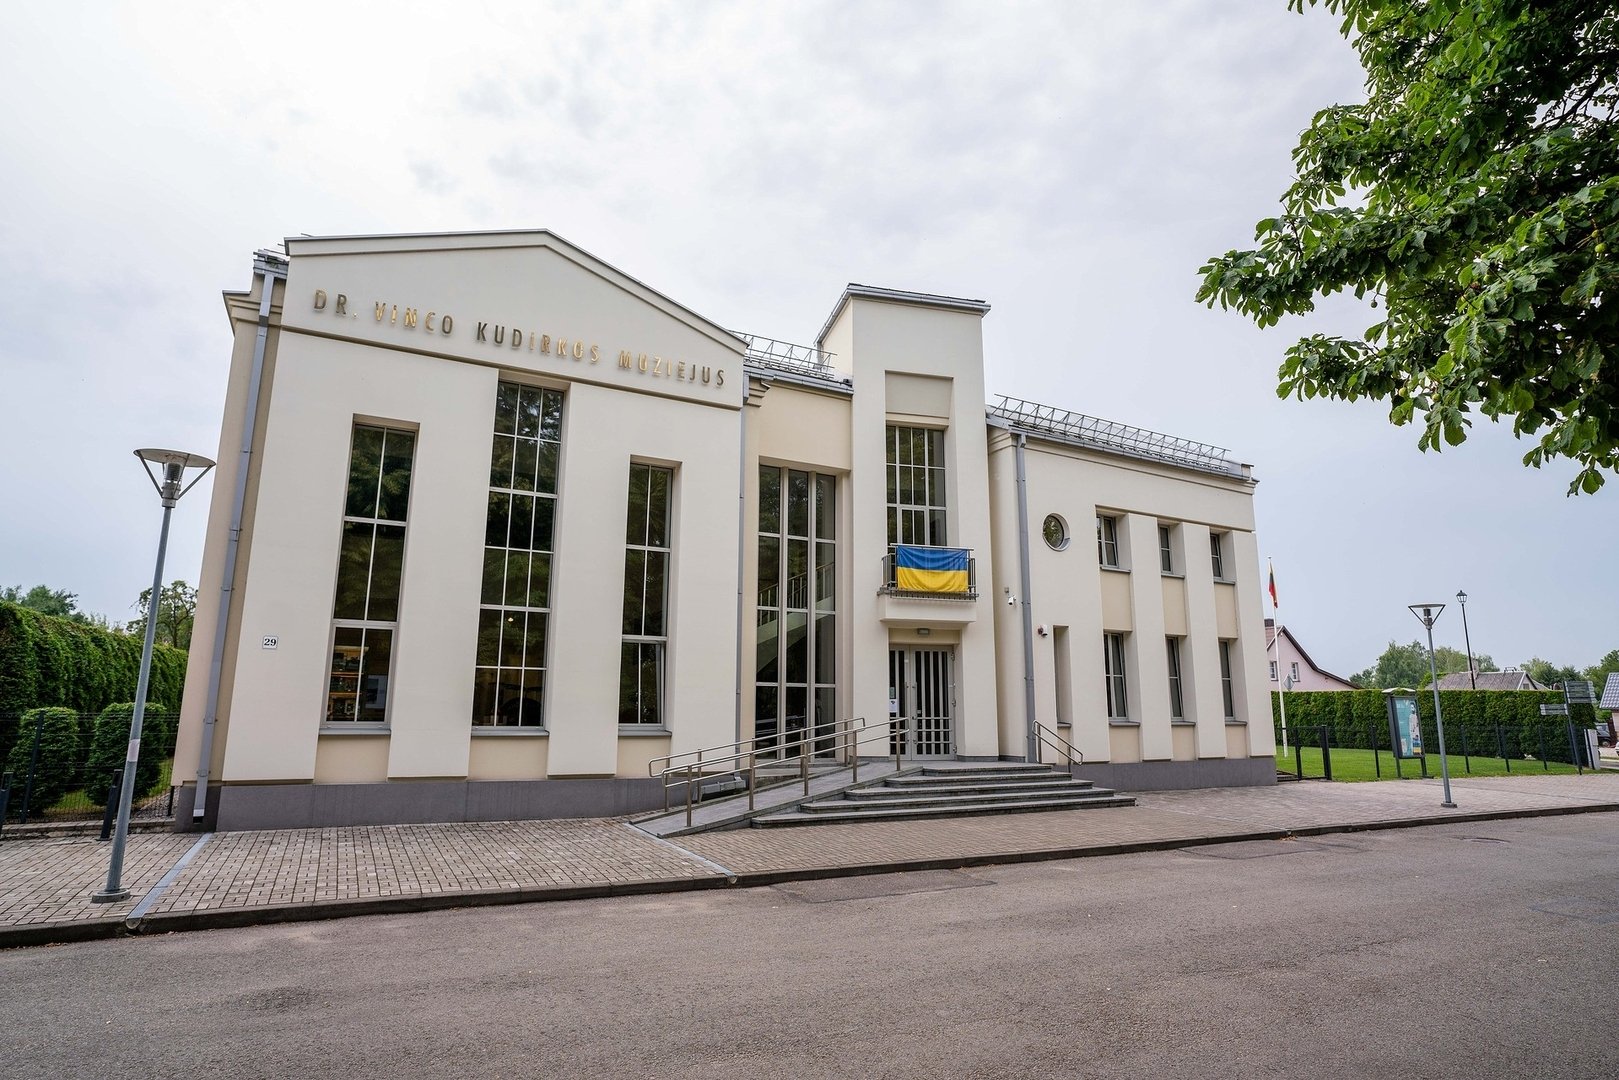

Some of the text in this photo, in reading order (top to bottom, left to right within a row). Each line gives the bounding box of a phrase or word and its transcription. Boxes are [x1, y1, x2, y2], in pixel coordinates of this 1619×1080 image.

[313, 289, 725, 386] DR. VINCO KUDIRKOS MUZIEJUS
[263, 638, 277, 647] 29
